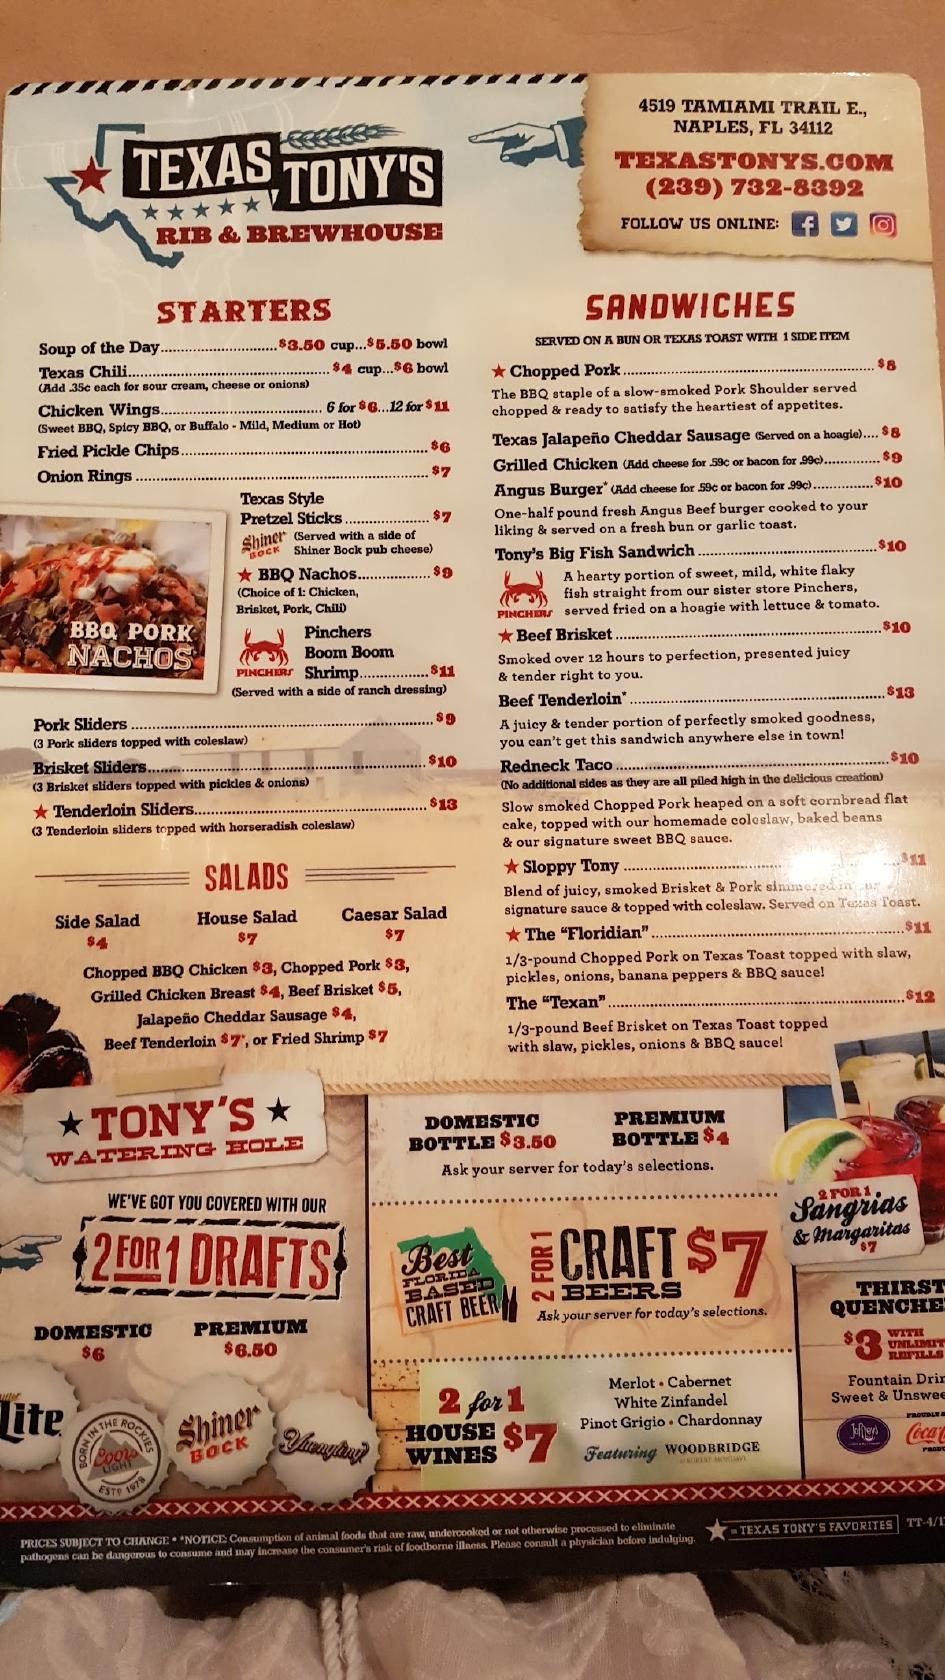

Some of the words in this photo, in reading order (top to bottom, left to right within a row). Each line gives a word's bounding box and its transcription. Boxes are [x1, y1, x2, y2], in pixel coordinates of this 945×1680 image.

[638, 98, 676, 113] 4519
[682, 99, 775, 113] TAMIAMI
[780, 100, 841, 115] TRAIL
[846, 102, 866, 117] E.,
[674, 120, 753, 136] NAPLES,
[758, 120, 784, 135] FL
[789, 121, 832, 135] 34112
[614, 151, 894, 172] TEXASTONYS.COM
[133, 140, 272, 192] TEXAS
[283, 153, 435, 204] TONY'S
[645, 178, 723, 199] (239)
[730, 179, 864, 198] 732-8392
[620, 216, 684, 230] FOLLOW
[689, 217, 711, 230] US
[716, 217, 780, 230] ONLINE:
[156, 227, 212, 245] RIB
[218, 225, 241, 243] &
[246, 222, 443, 243] BREWHOUSE
[157, 298, 332, 324] STARTERS
[586, 292, 796, 321] SANDWICHES
[535, 335, 581, 347] SERVED
[582, 335, 602, 346] ON
[604, 335, 614, 345] A
[616, 334, 641, 345] BUN
[642, 334, 662, 345] OR
[663, 333, 703, 344] TEXAS
[704, 332, 744, 344] TOAST
[745, 331, 778, 343] WITH
[783, 331, 789, 342] 1
[790, 331, 818, 342] SIDE
[819, 331, 851, 341] ITEM
[38, 383, 66, 394] (Add
[68, 382, 91, 393] .35c
[93, 382, 121, 393] each
[123, 381, 140, 392] for
[142, 383, 168, 392] sour
[170, 382, 209, 392] cream,
[211, 380, 251, 390] cheese
[268, 379, 310, 389] onions)
[491, 387, 517, 400] The
[519, 388, 549, 401] BBQ
[552, 386, 593, 401] staple
[596, 386, 610, 398] of
[613, 390, 621, 398] a
[624, 383, 711, 397] slow-smoked
[714, 383, 746, 395] Pork
[749, 382, 809, 395] Shoulder
[812, 381, 857, 393] served
[37, 444, 79, 459] Fried
[82, 443, 131, 458] Pickle
[135, 444, 180, 459] Chips
[431, 440, 450, 454] $6
[495, 548, 544, 563] Tony's
[549, 547, 575, 562] Big
[579, 545, 615, 560] Fish
[619, 544, 696, 558] Sandwich
[878, 539, 907, 553] $10
[563, 571, 574, 582] A
[576, 569, 621, 584] hearty
[624, 569, 675, 584] portion
[678, 567, 693, 580] of
[695, 568, 738, 580] sweet,
[741, 565, 777, 579] mild,
[779, 564, 818, 577] white
[820, 563, 856, 578] flaky
[70, 621, 116, 641] BBQ
[128, 624, 194, 643] PORK
[67, 646, 194, 670] NACHOS
[34, 718, 70, 732] Pork
[74, 717, 128, 732] Sliders
[436, 712, 456, 726] $9
[205, 862, 289, 892] SALADS
[56, 915, 90, 929] Side
[96, 914, 140, 928] Salad
[197, 911, 249, 926] House
[253, 910, 298, 924] Salad
[341, 907, 400, 922] Caesar
[404, 906, 447, 920] Salad
[87, 936, 108, 950] $4
[238, 932, 258, 946] $7
[385, 928, 405, 942] $7
[506, 970, 559, 985] pickles,
[564, 970, 615, 984] onions,
[617, 968, 669, 981] banana
[671, 970, 729, 983] peppers
[731, 967, 743, 979] &
[745, 966, 778, 981] BBQ
[780, 965, 825, 978] sauce!
[136, 1012, 199, 1029] Jalapeño
[203, 1009, 266, 1024] Cheddar
[269, 1009, 328, 1024] Sausage
[332, 1007, 356, 1021] $4,
[91, 1096, 255, 1141] TONY'S
[425, 1113, 540, 1131] DOMESTIC
[614, 1110, 726, 1126] PREMIUM
[408, 1134, 495, 1152] BOTTLE
[499, 1131, 557, 1150] $3.50
[612, 1129, 699, 1147] BOTTLE
[703, 1127, 730, 1146] $4
[46, 1142, 217, 1167] WATERING
[226, 1135, 304, 1155] HOLE
[108, 1194, 147, 1209] WE'VE
[150, 1195, 175, 1210] GOT
[179, 1195, 202, 1210] YOU
[206, 1196, 262, 1211] COVERED
[266, 1197, 297, 1212] WITH
[302, 1198, 326, 1213] OUR
[790, 1192, 909, 1225] Sangrias
[792, 1230, 808, 1245] &
[814, 1222, 910, 1244] Margaritas
[859, 1240, 878, 1254] $7
[91, 1232, 112, 1282] 2
[115, 1235, 161, 1271] FOR
[166, 1235, 178, 1284] 1
[189, 1233, 331, 1289] DRAFTS
[560, 1226, 677, 1280] CRAFT
[687, 1226, 768, 1298] $7
[561, 1281, 682, 1301] BEERS
[34, 1323, 153, 1341] DOMESTIC
[193, 1319, 308, 1336] PREMIUM
[81, 1346, 105, 1362] $6
[224, 1342, 278, 1358] $6.50
[843, 1328, 883, 1362] $3
[608, 1375, 656, 1390] Merlot
[667, 1374, 732, 1389] Cabernet
[847, 1374, 912, 1388] Fountain
[438, 1387, 461, 1414] 2
[466, 1390, 504, 1419] for
[507, 1386, 525, 1412] 1
[613, 1395, 658, 1409] White
[661, 1393, 727, 1407] Zinfandel
[831, 1391, 874, 1404] Sweet
[878, 1390, 889, 1403] &
[176, 1404, 261, 1451] Shiner
[579, 1417, 618, 1430] Pinot
[621, 1416, 665, 1430] Grigio
[678, 1413, 762, 1427] Chardonnay
[190, 1437, 249, 1464] BOCK
[278, 1428, 371, 1464] Yuengling
[405, 1422, 496, 1443] HOUSE
[503, 1421, 558, 1464] $7
[406, 1445, 498, 1466] WINES
[739, 1523, 780, 1536] TEXAS
[782, 1522, 826, 1534] TONY'S
[828, 1519, 893, 1532] FAVORITES
[20, 1538, 58, 1549] PRICES
[59, 1537, 103, 1549] SUBJECT
[105, 1536, 121, 1547] TO
[123, 1535, 170, 1546] CHANGE
